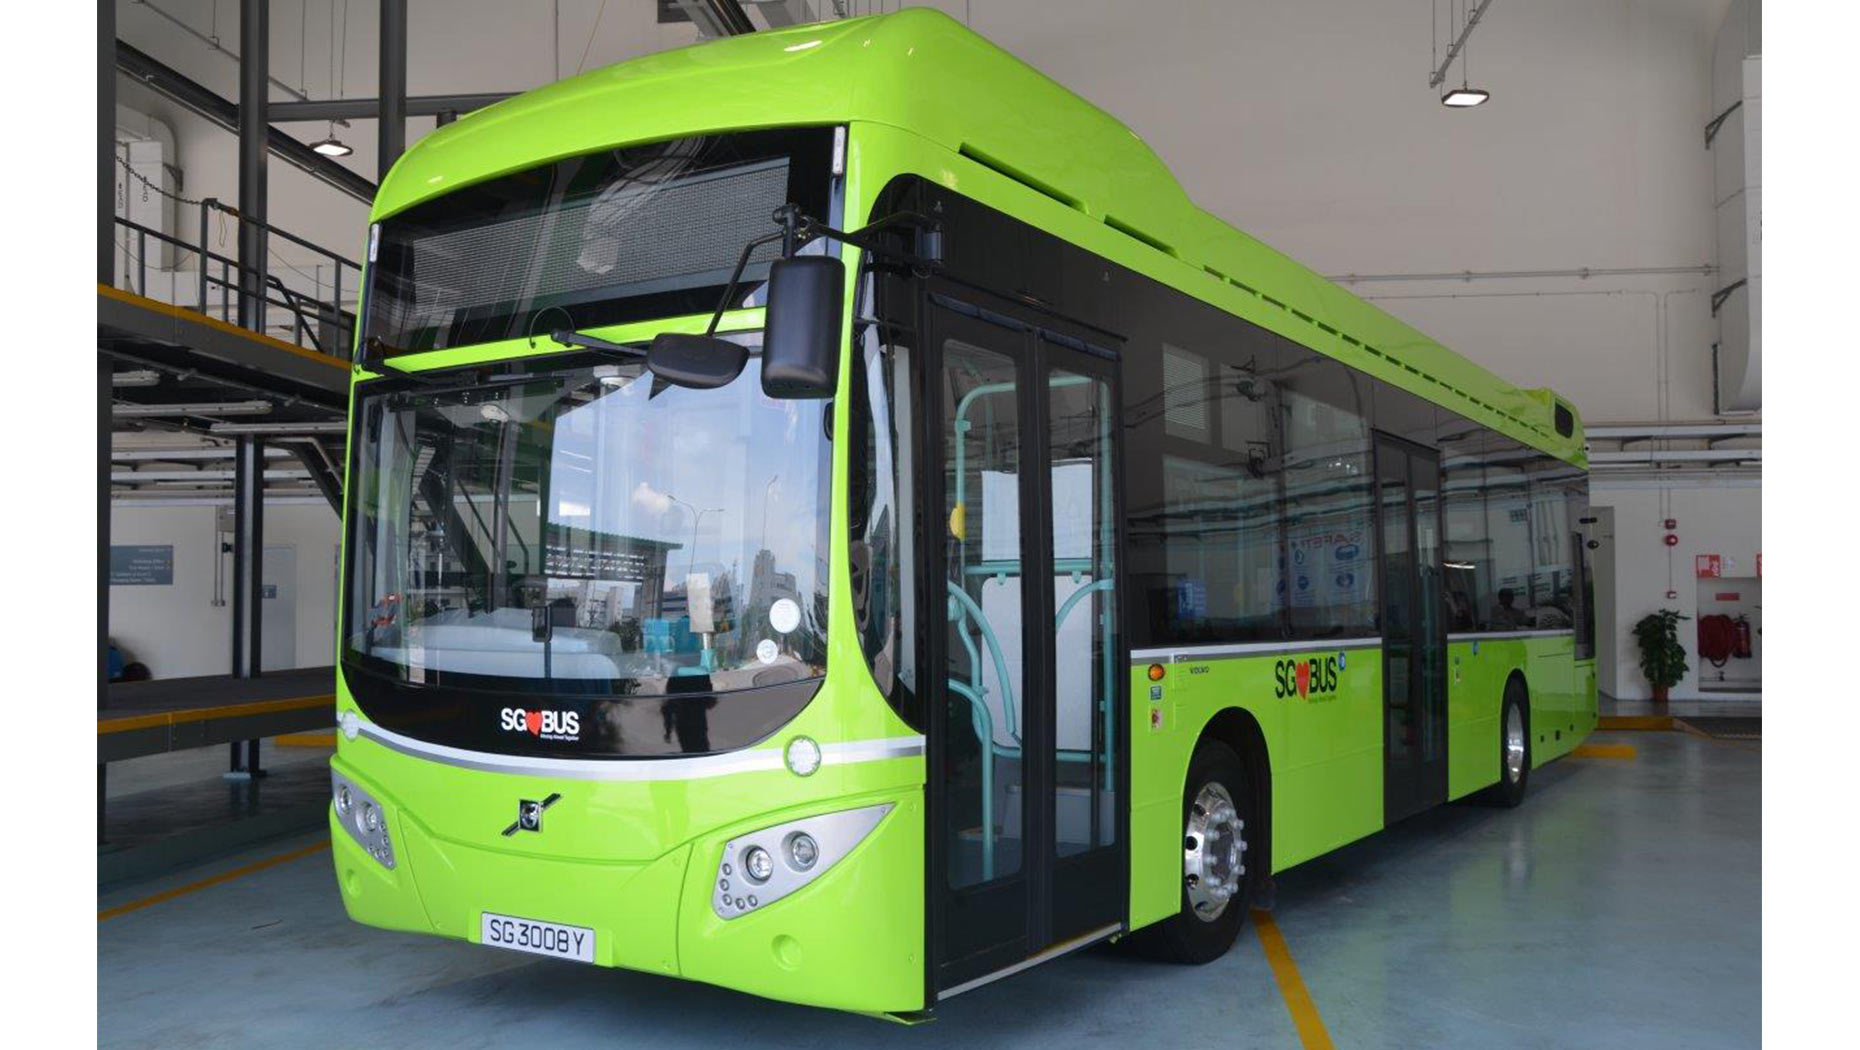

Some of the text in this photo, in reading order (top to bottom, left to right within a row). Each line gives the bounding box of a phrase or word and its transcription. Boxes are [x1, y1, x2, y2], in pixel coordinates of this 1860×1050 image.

[1275, 656, 1337, 699] SG BUS
[501, 707, 580, 735] SG BUS
[490, 919, 584, 955] SG3008Y
